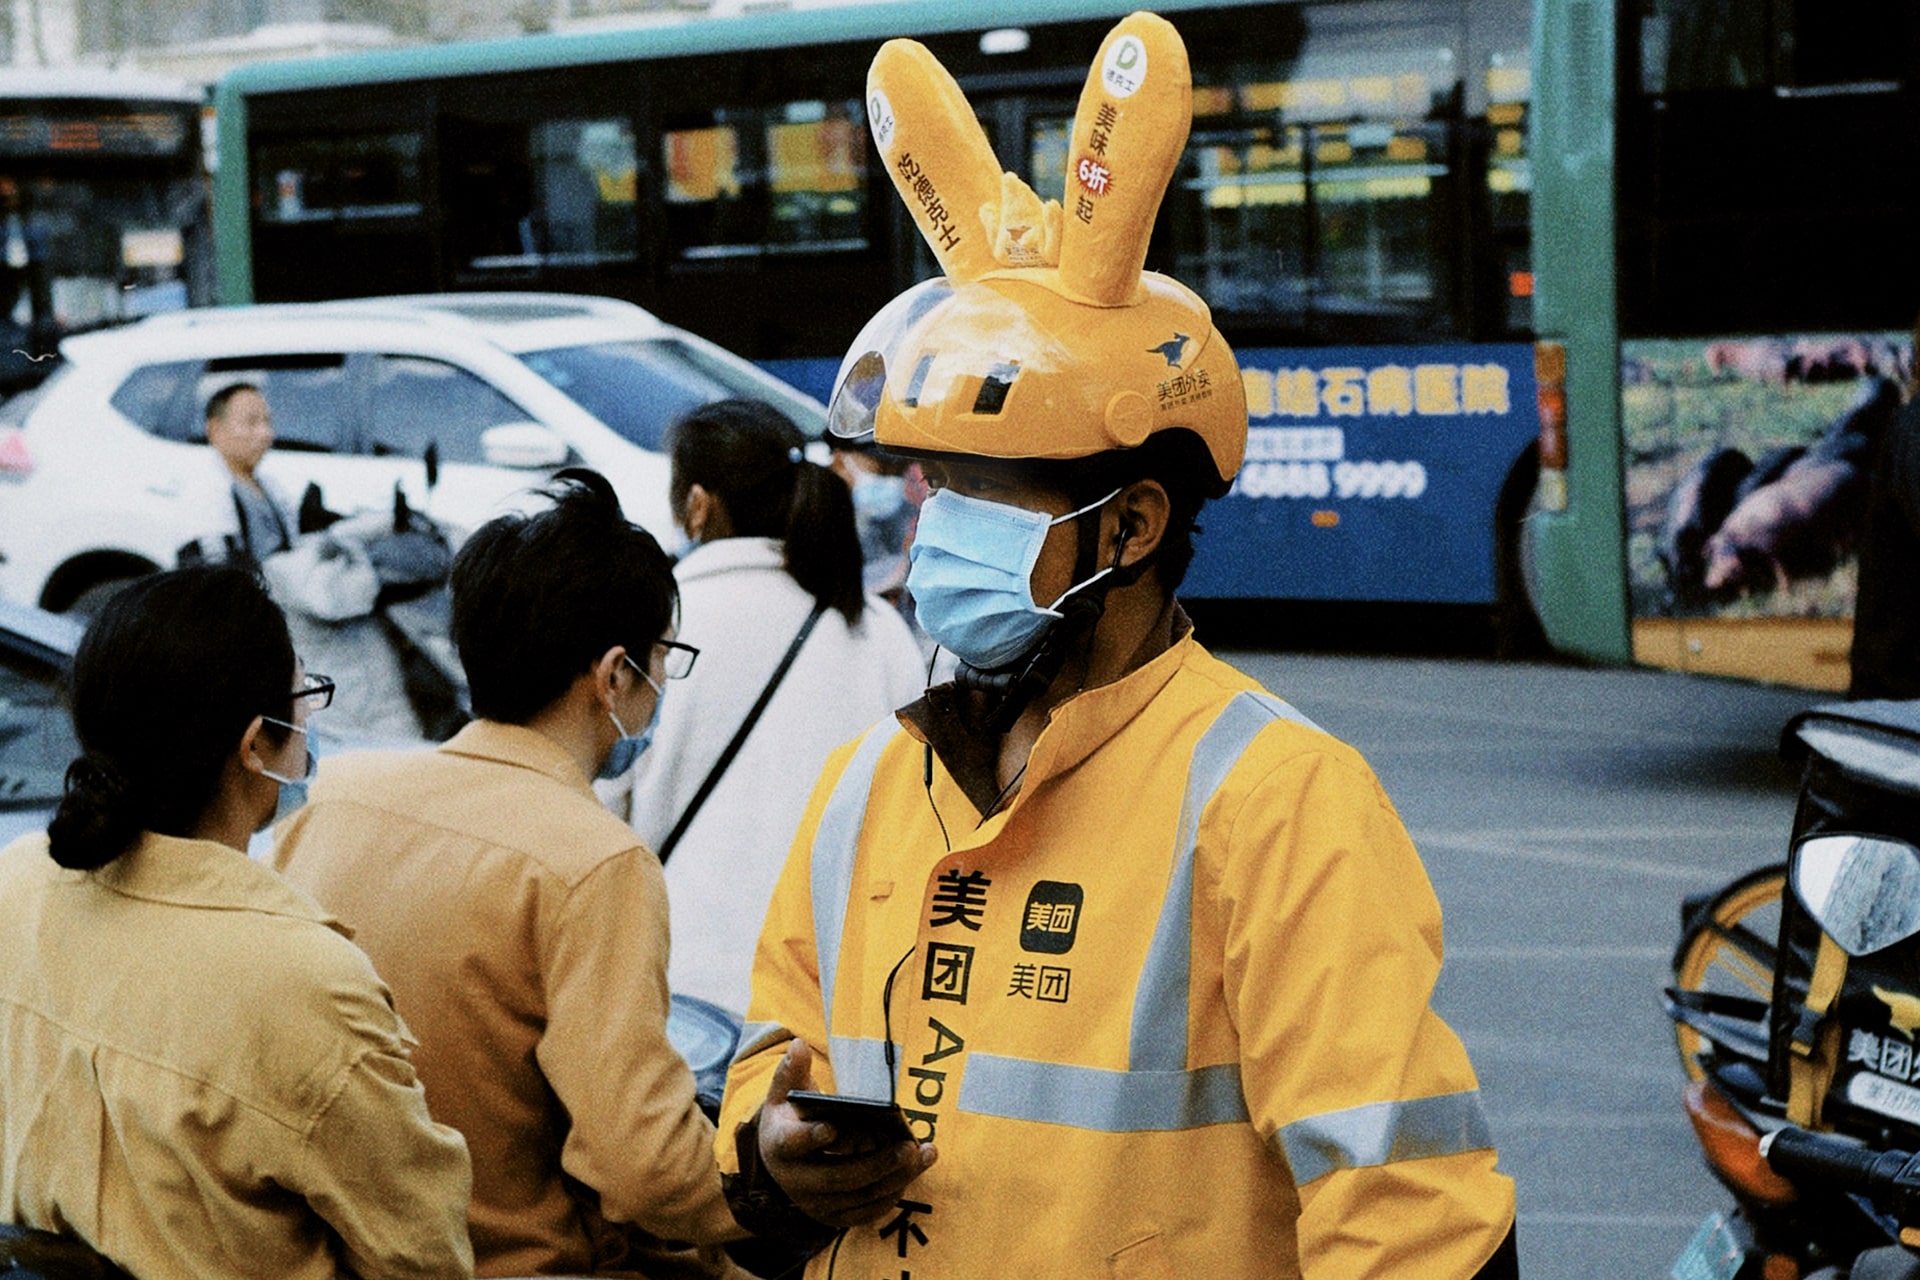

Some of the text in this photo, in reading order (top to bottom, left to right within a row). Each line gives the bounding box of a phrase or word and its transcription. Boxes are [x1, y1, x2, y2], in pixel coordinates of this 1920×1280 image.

[1090, 103, 1118, 156] 美味
[1078, 159, 1110, 195] 6折
[1156, 369, 1211, 401] 美团外卖
[1026, 901, 1076, 933] 美团
[1007, 963, 1072, 1003] 美团
